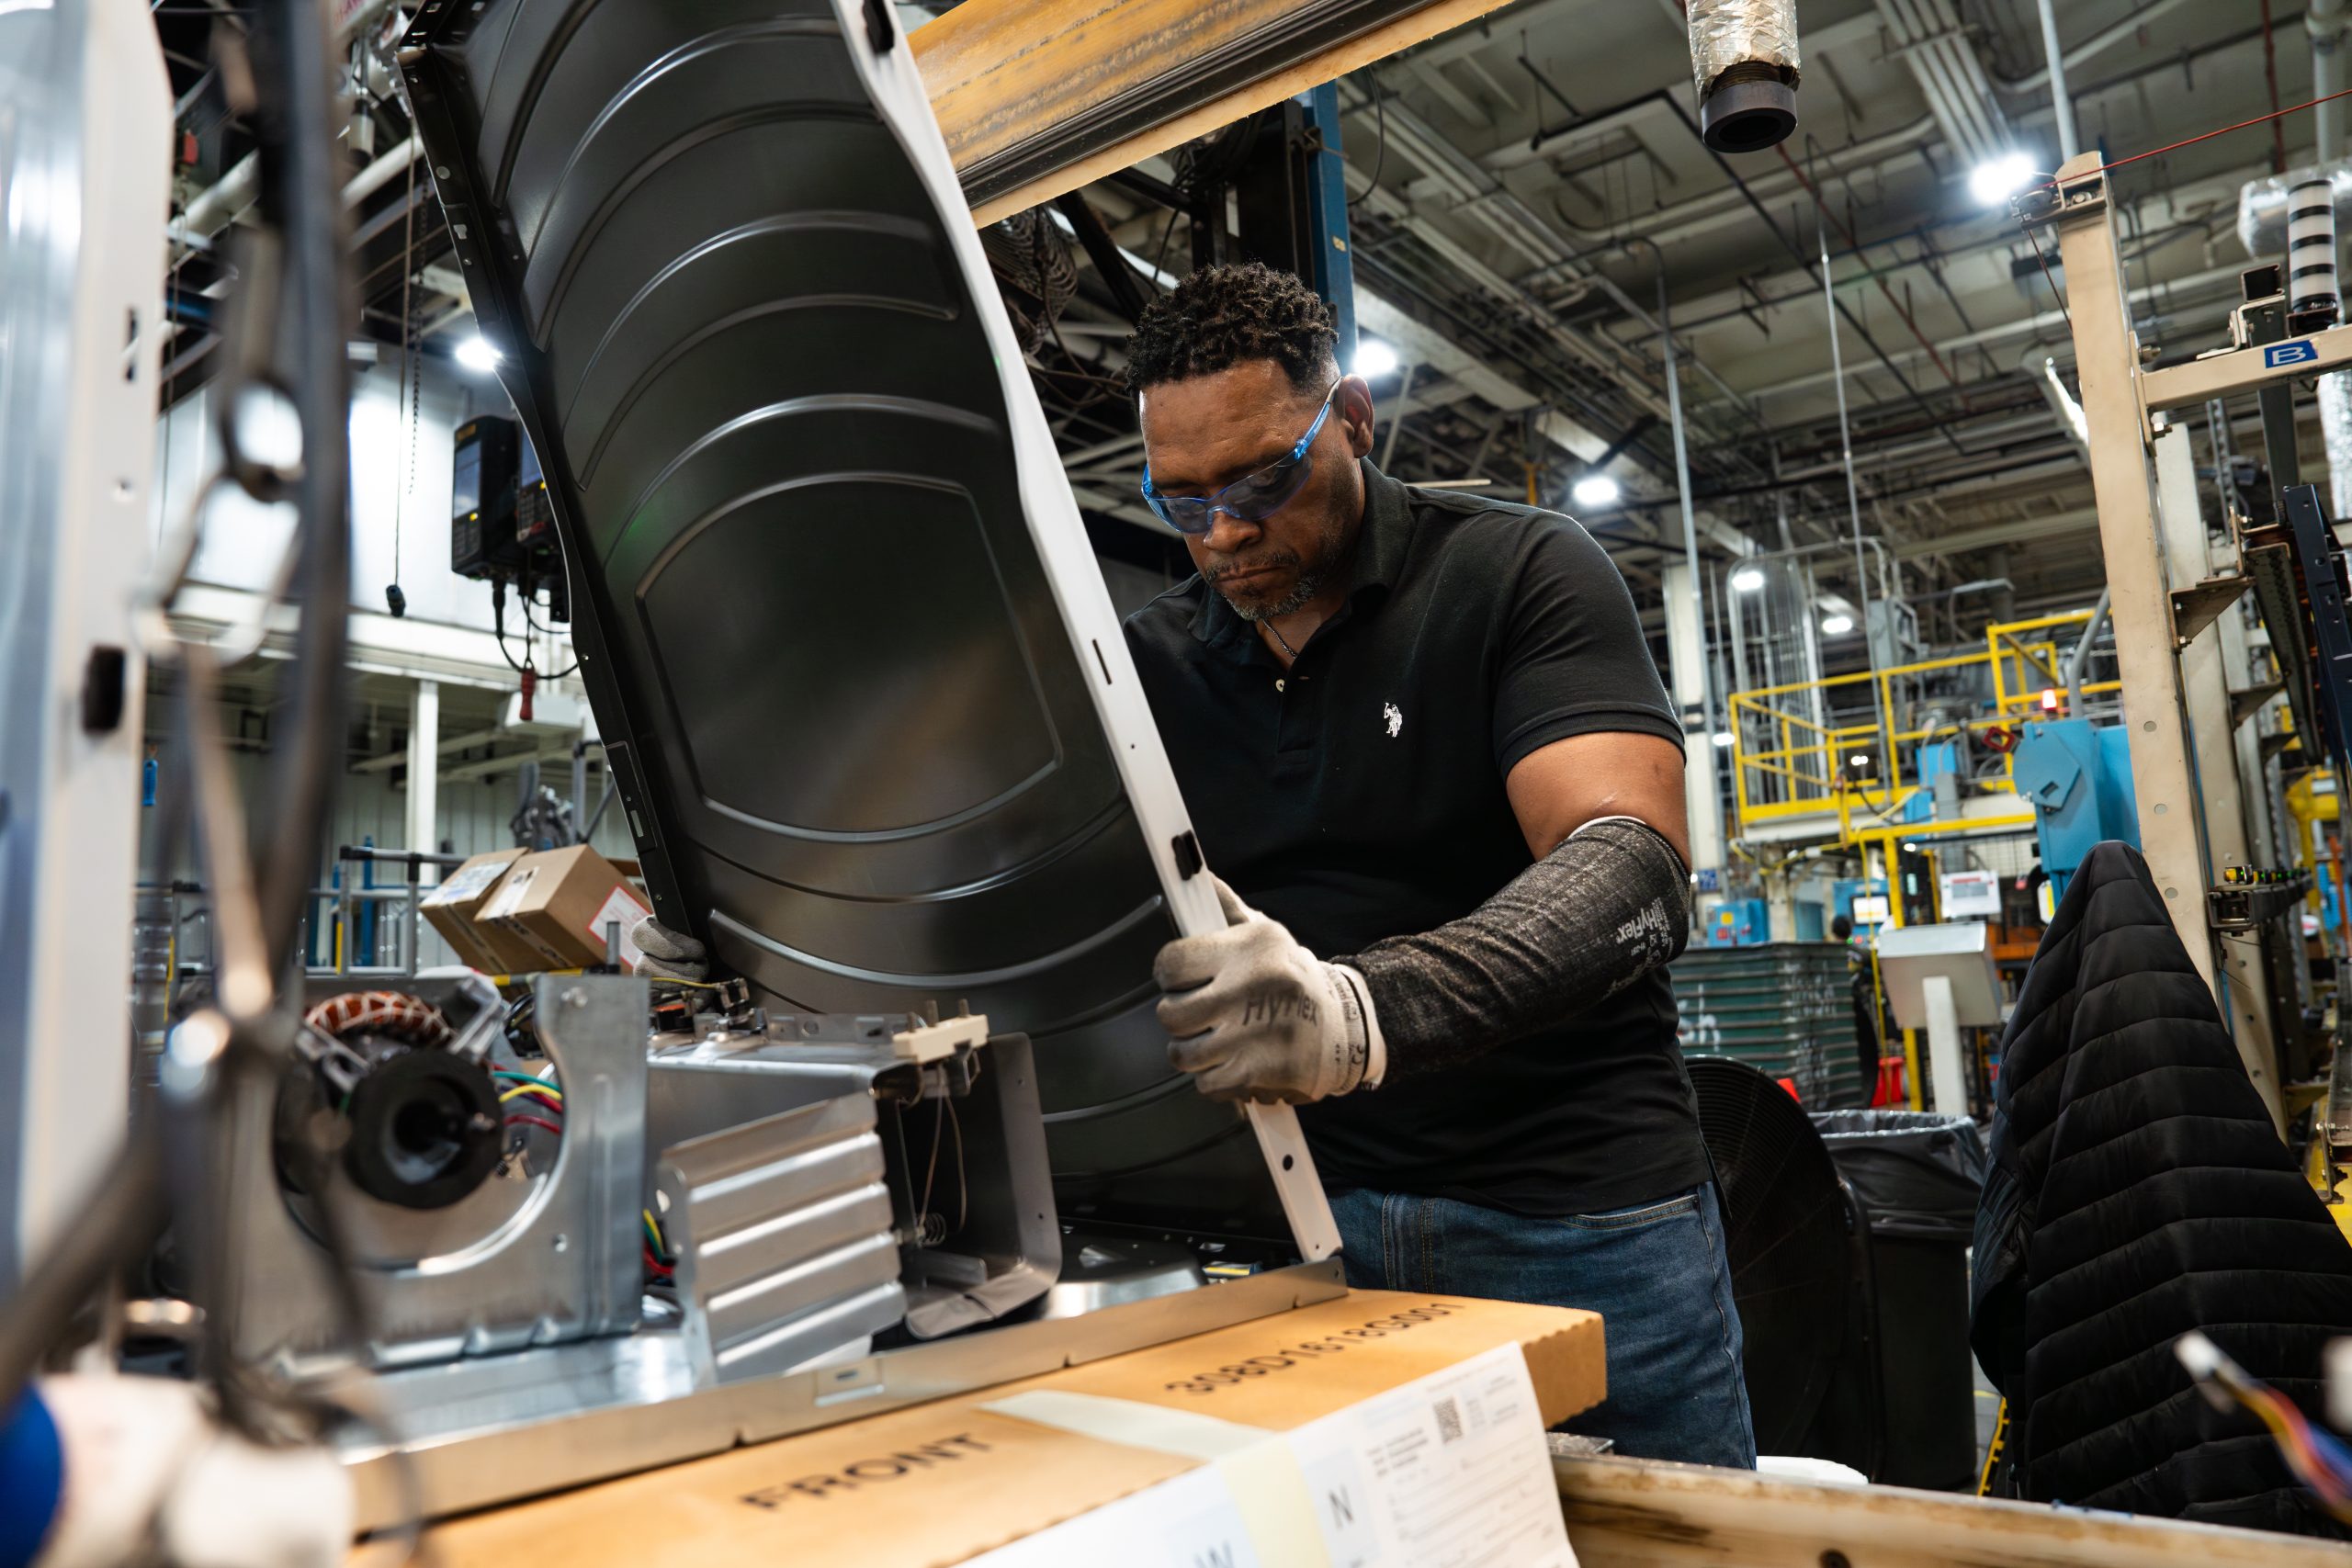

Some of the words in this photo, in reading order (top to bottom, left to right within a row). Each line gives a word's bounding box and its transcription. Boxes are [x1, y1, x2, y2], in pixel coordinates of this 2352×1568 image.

[2272, 346, 2307, 366] B
[1241, 990, 1318, 1028] HyFlex
[739, 1432, 992, 1512] FRONT
[1328, 1483, 1355, 1531] N
